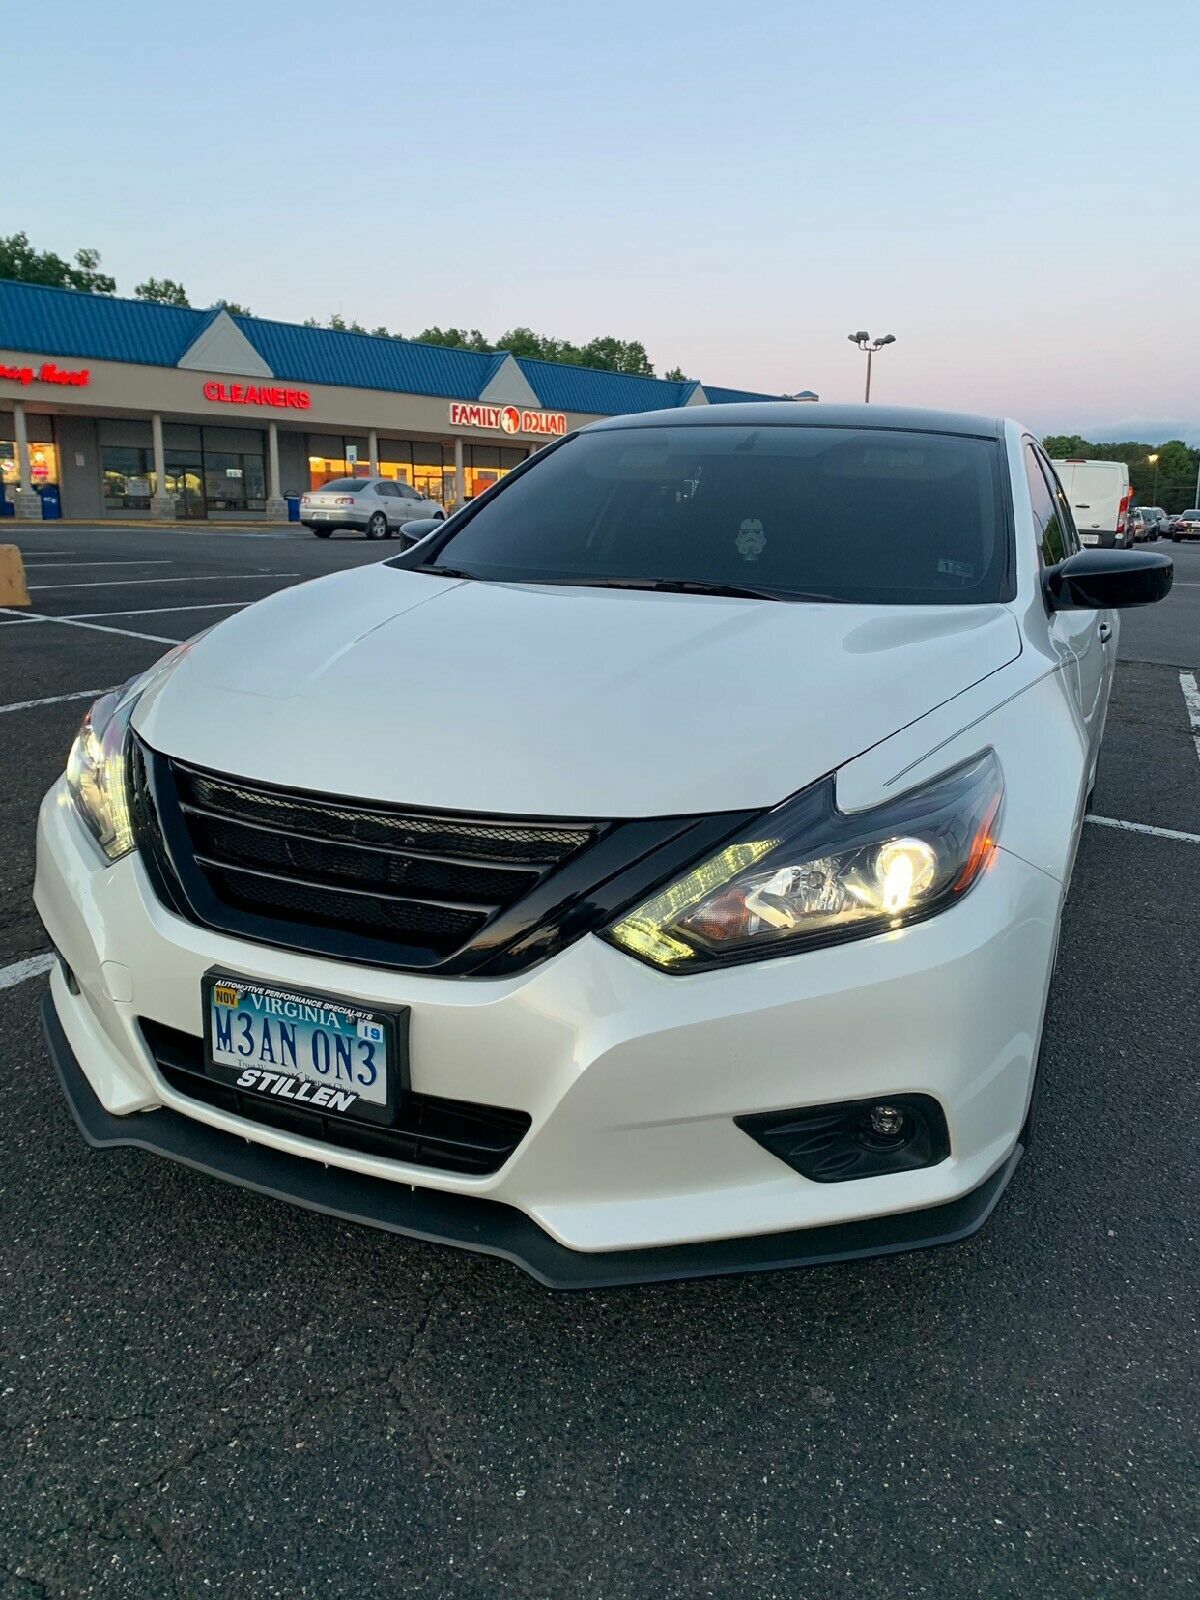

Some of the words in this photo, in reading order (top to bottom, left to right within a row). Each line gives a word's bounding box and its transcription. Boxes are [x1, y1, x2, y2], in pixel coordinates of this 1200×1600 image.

[203, 382, 312, 409] CLEANERS
[450, 403, 501, 428] FAMILY
[522, 411, 566, 435] DOLLAR
[215, 980, 264, 995] AUTOMOTIVE
[264, 989, 323, 1009] PERFORMANCE
[323, 1002, 373, 1020] SPECIALISTS
[216, 990, 235, 1005] NOV
[251, 993, 341, 1029] VIRGINIA
[214, 1006, 298, 1069] M3AN
[363, 1025, 380, 1040] 19
[236, 1069, 357, 1112] STILLEN
